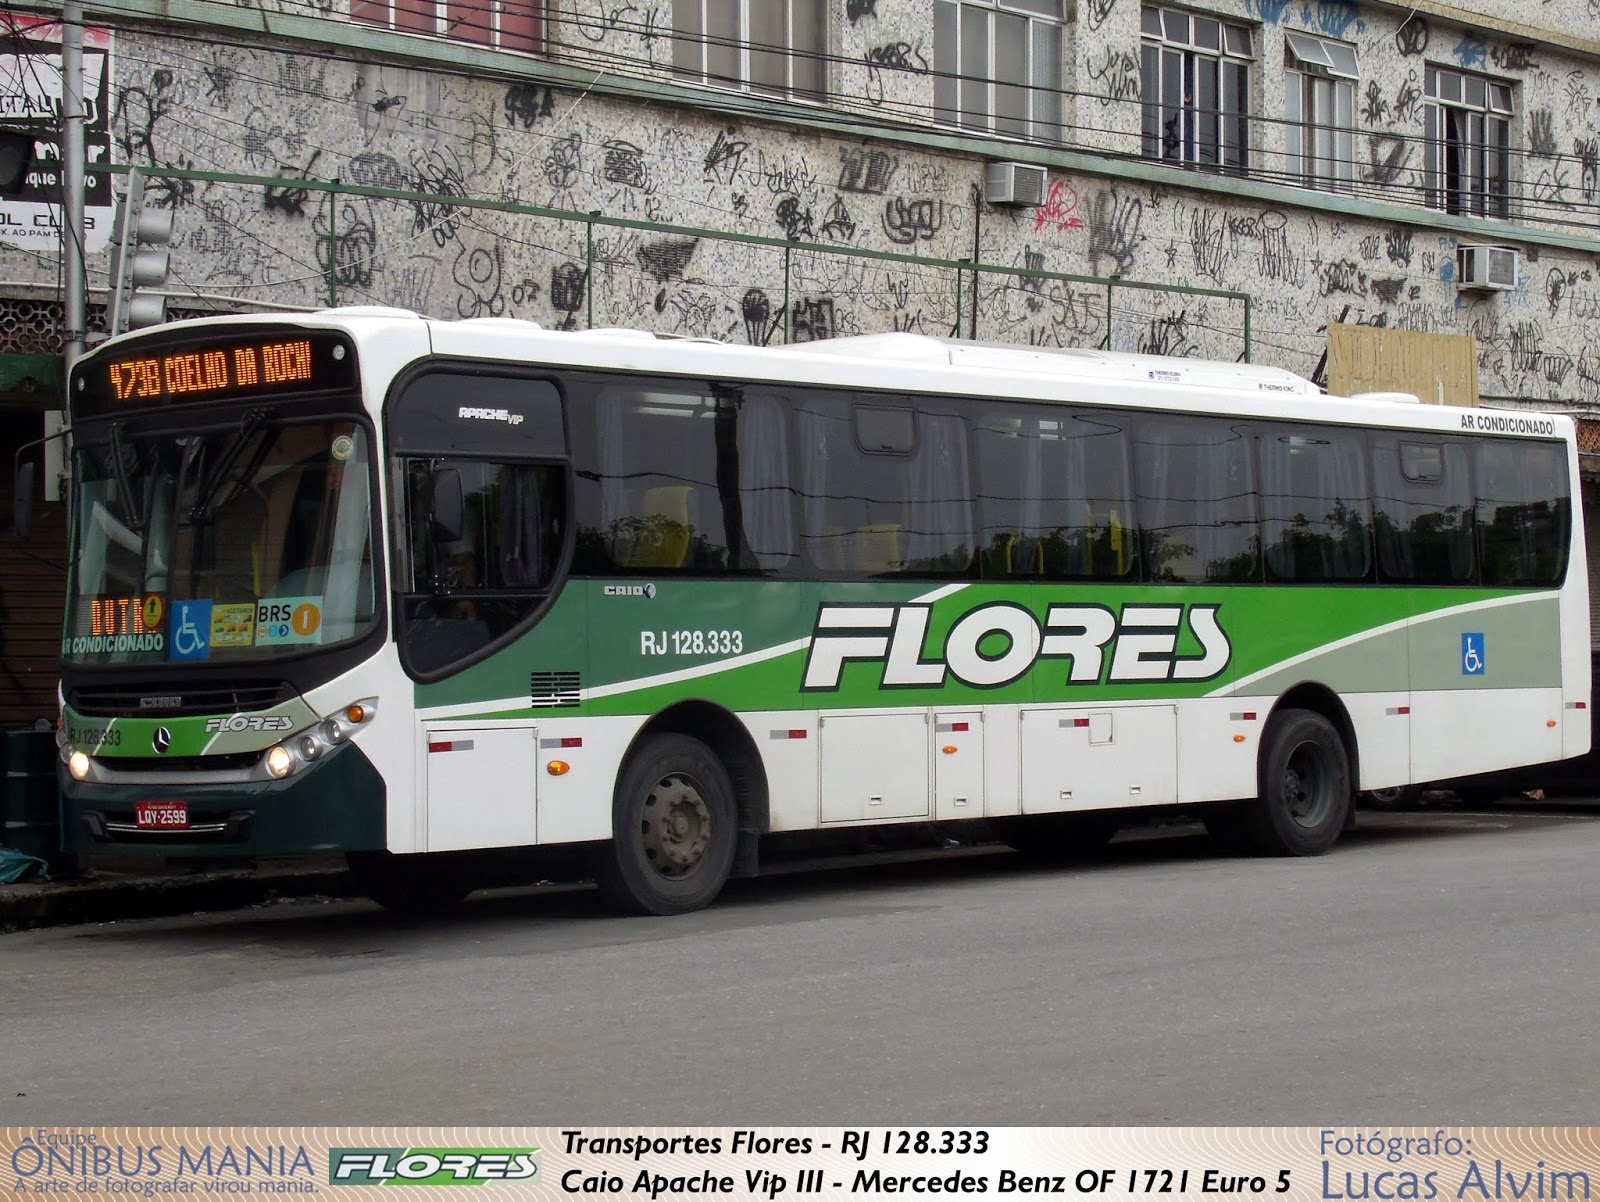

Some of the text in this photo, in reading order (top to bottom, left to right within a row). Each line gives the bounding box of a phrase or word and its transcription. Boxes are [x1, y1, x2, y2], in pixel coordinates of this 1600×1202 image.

[34, 214, 95, 230] CLB
[12, 229, 27, 237] AO
[29, 230, 51, 238] PAM
[164, 351, 228, 393] COELHO
[234, 347, 258, 386] DA
[459, 407, 524, 424] APACHE VIP
[1461, 414, 1553, 435] AR CONDICIONADO
[604, 585, 645, 596] CAIO
[91, 598, 158, 636] DUTR
[258, 604, 291, 623] BRS
[72, 633, 164, 654] CONDICIONADO
[640, 630, 743, 655] RJ 128.333
[800, 600, 1233, 692] FLORES
[205, 715, 294, 733] FLORES
[70, 728, 122, 746] RJ 128.333
